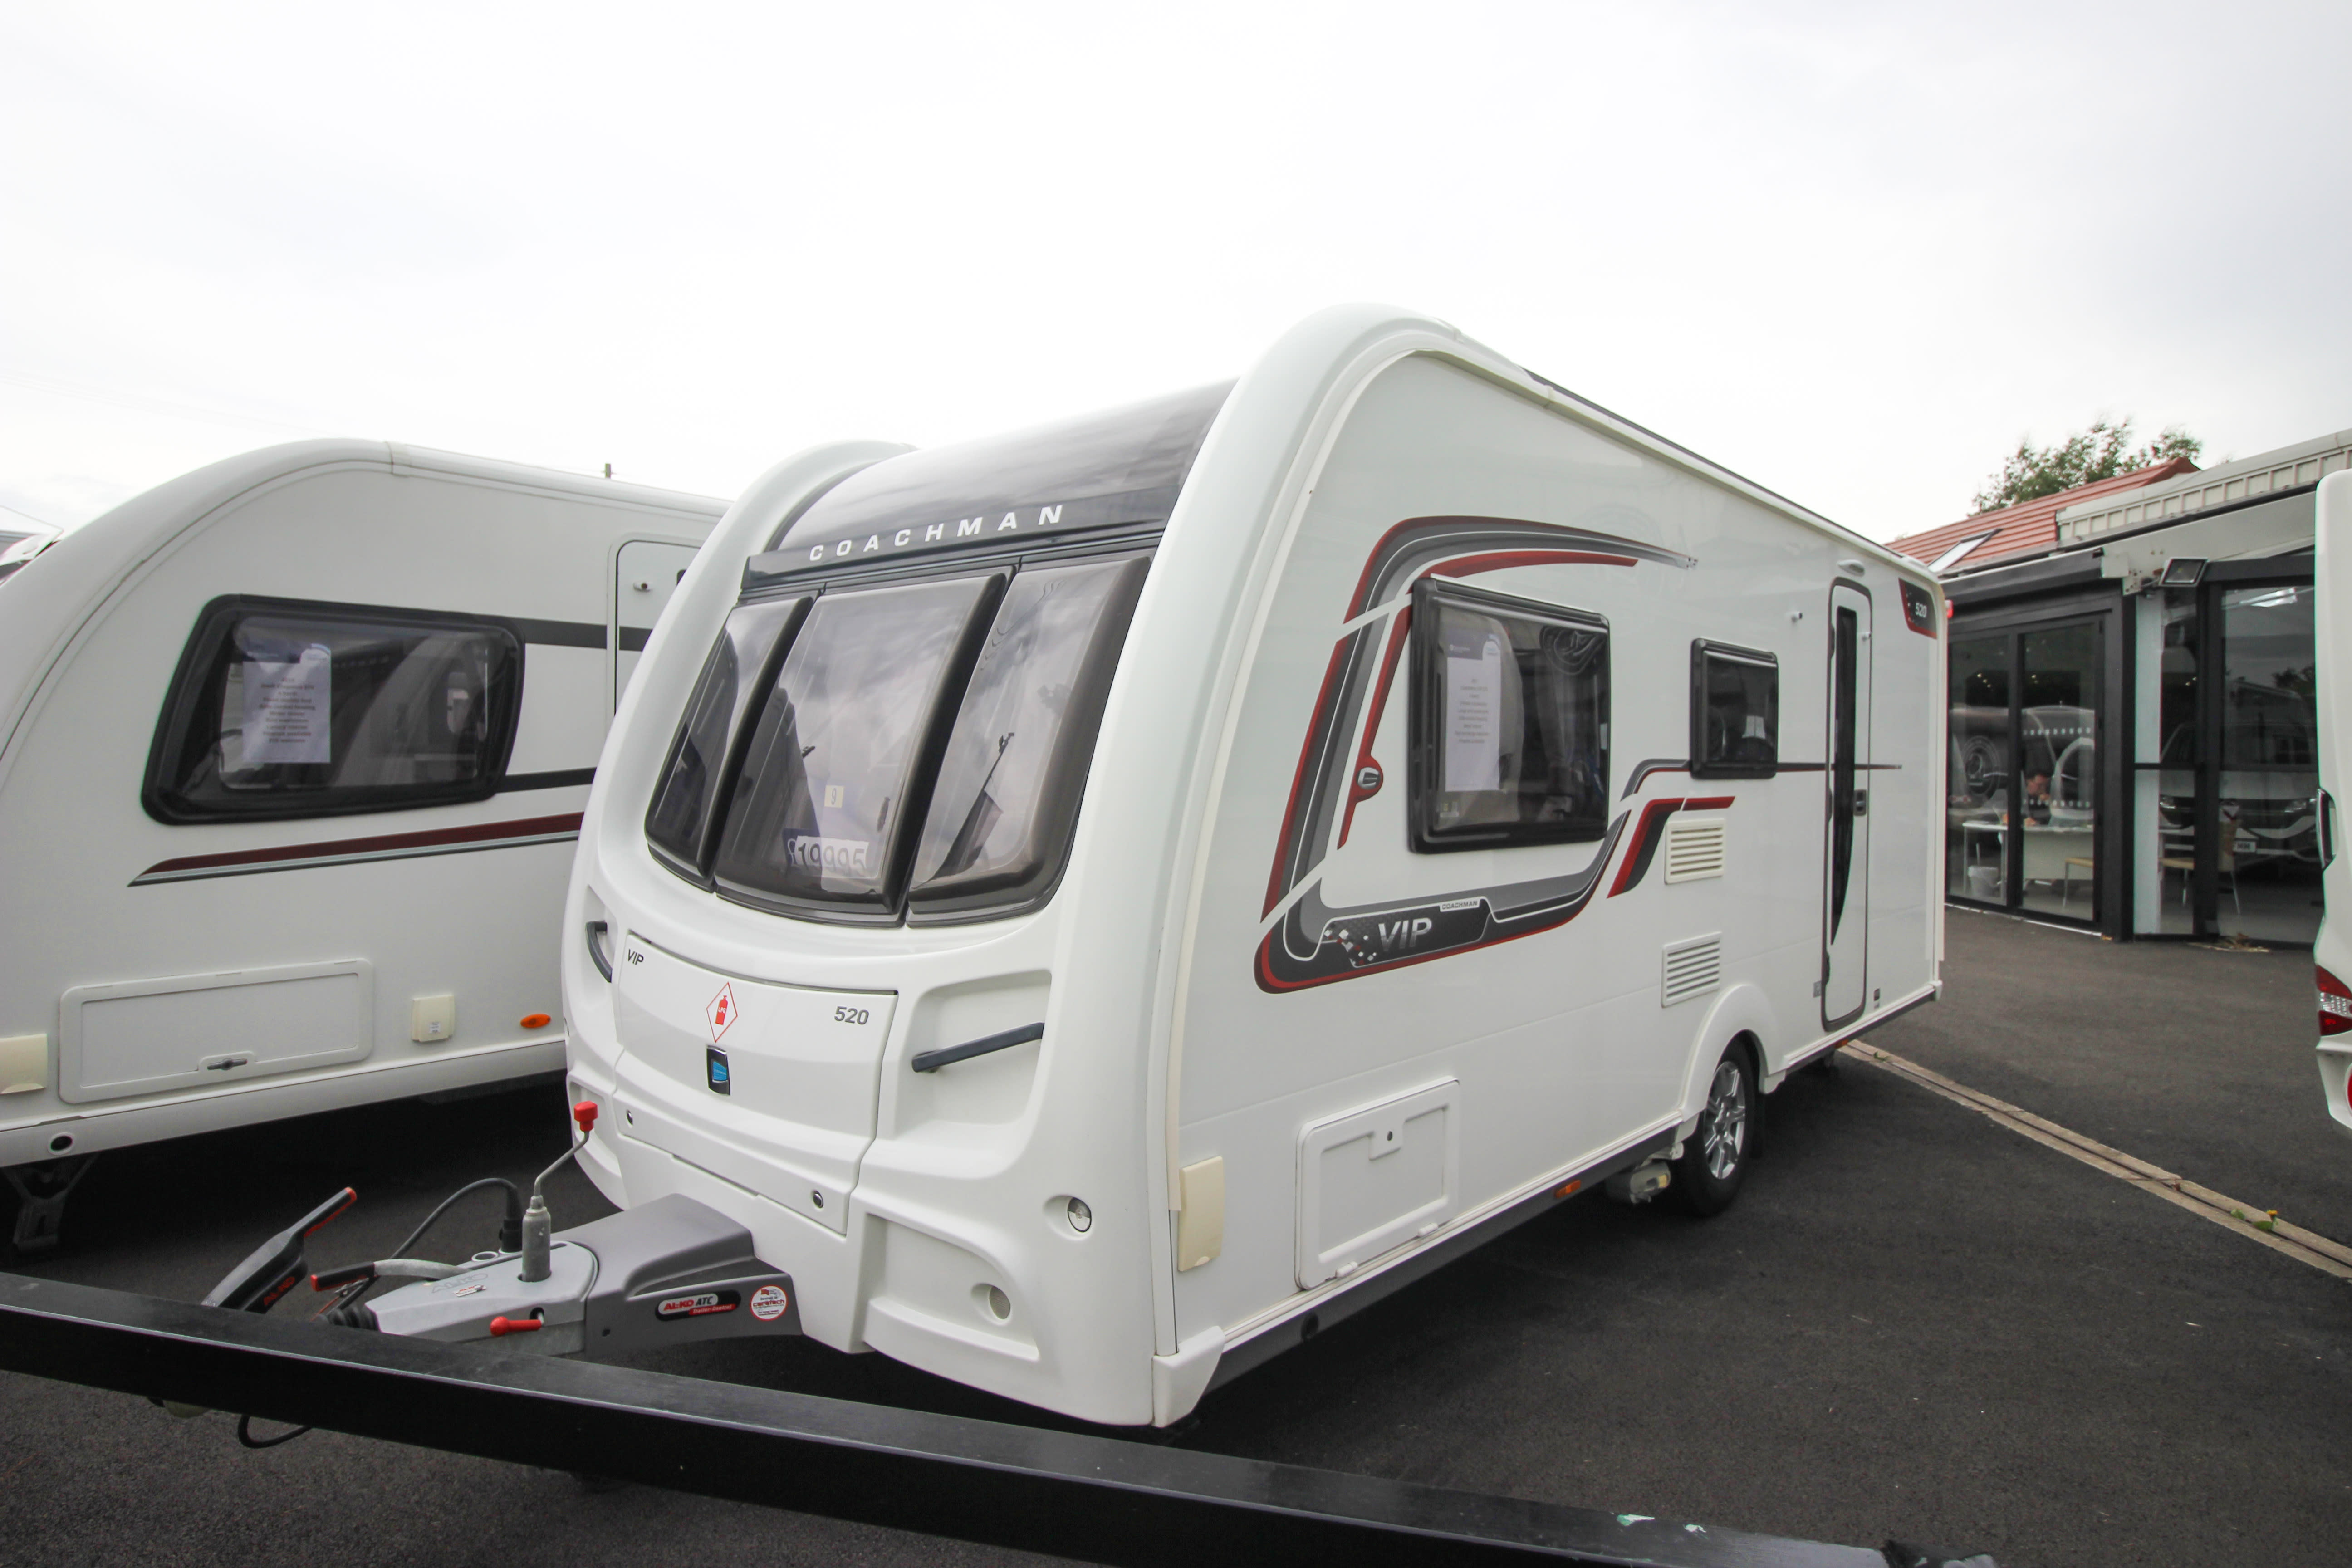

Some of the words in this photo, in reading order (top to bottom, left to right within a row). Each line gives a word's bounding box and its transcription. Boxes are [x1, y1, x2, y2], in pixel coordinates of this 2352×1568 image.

[809, 505, 1062, 560] COACHMAN
[1916, 602, 1927, 618] 520
[1442, 901, 1477, 910] COACHMAN
[1378, 918, 1432, 951] VIP
[627, 949, 644, 965] VIP
[834, 1006, 869, 1025] 520
[696, 1296, 713, 1306] ATC
